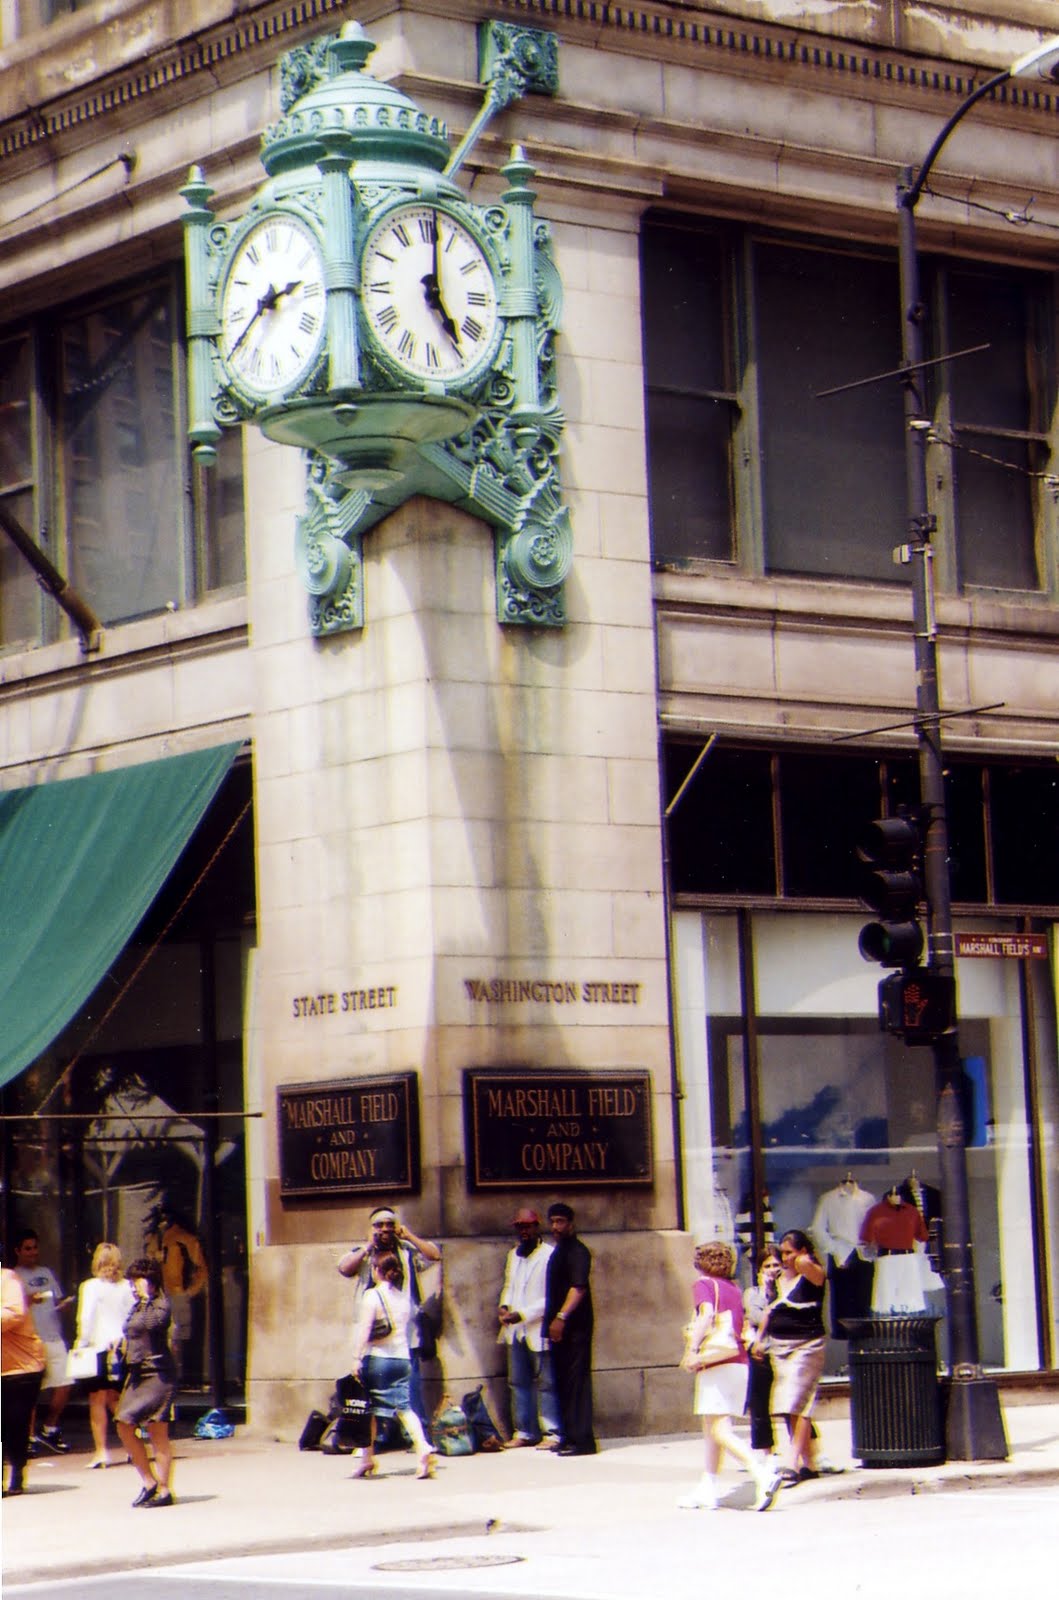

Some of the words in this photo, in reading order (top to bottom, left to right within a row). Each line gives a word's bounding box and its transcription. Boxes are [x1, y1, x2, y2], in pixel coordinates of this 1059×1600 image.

[960, 943, 999, 955] MARSHALL
[293, 994, 335, 1017] STATE
[341, 986, 397, 1012] STREET
[464, 979, 577, 1003] WASHINGTON
[582, 982, 640, 1004] STREET
[287, 1096, 356, 1129] MARSHALL
[361, 1093, 399, 1122] FIELD
[488, 1088, 583, 1117] MARSHALL
[589, 1088, 636, 1116] FIELD
[330, 1130, 356, 1146] AND
[546, 1122, 581, 1137] AND
[311, 1149, 378, 1180] COMPANY
[521, 1143, 609, 1171] COMPANY
